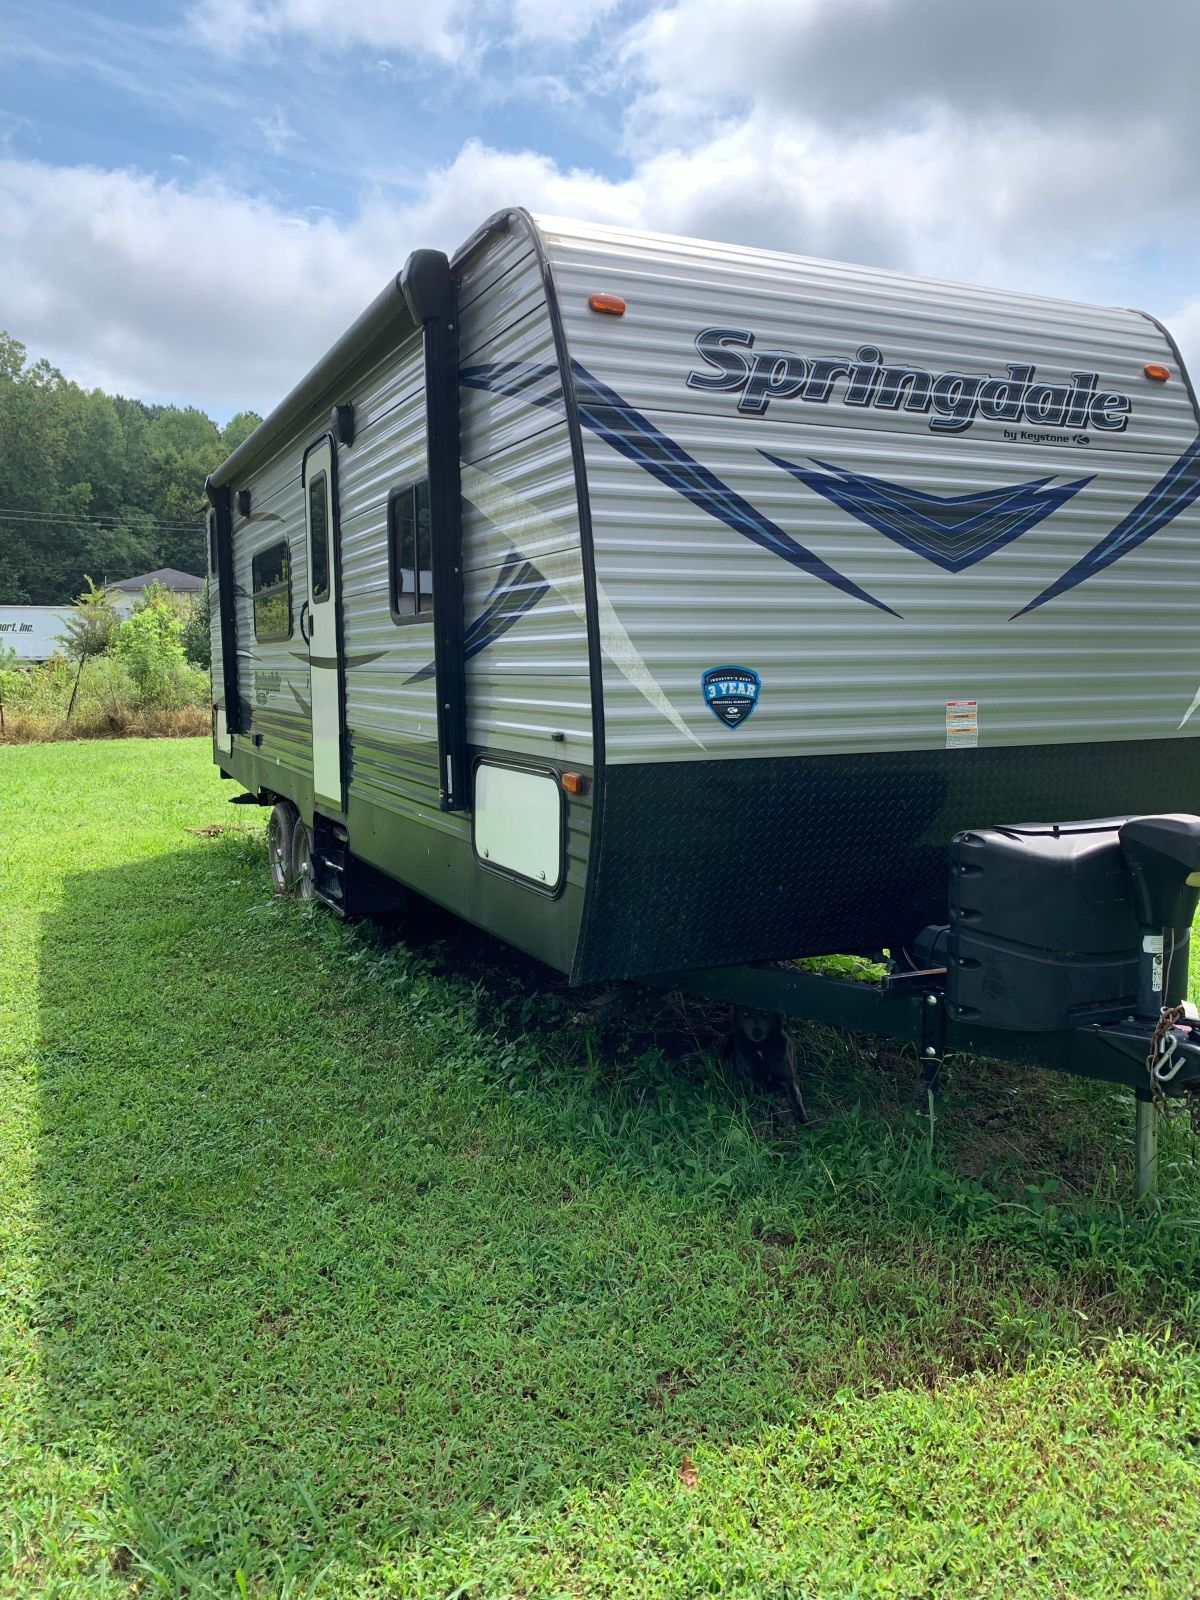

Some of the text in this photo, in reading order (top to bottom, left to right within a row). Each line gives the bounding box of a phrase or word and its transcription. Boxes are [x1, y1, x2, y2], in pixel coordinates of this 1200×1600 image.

[686, 327, 1132, 432] Springdale
[1003, 429, 1069, 443] by Keystone
[708, 682, 756, 698] 3 YEAR
